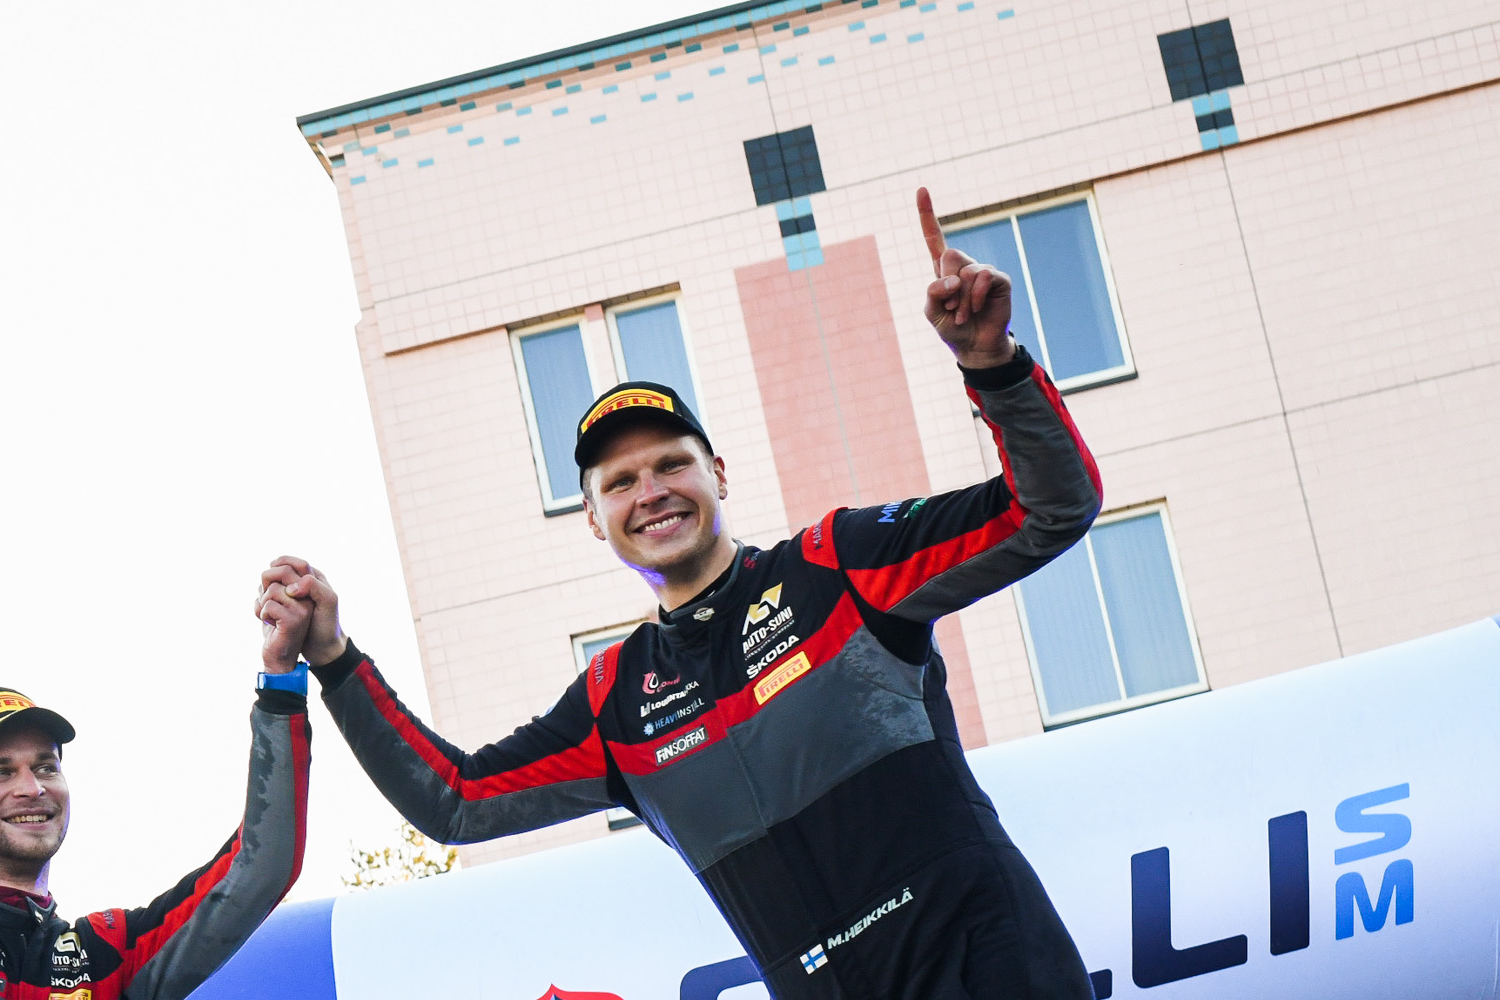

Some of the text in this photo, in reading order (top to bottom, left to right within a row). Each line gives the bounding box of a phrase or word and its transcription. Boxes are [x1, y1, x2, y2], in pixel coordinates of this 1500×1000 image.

[742, 606, 794, 654] AUTO-SUNI
[746, 634, 800, 679] ŠKODA
[758, 657, 805, 698] PIRELLI
[827, 886, 914, 950] M.HEIKKILÄ
